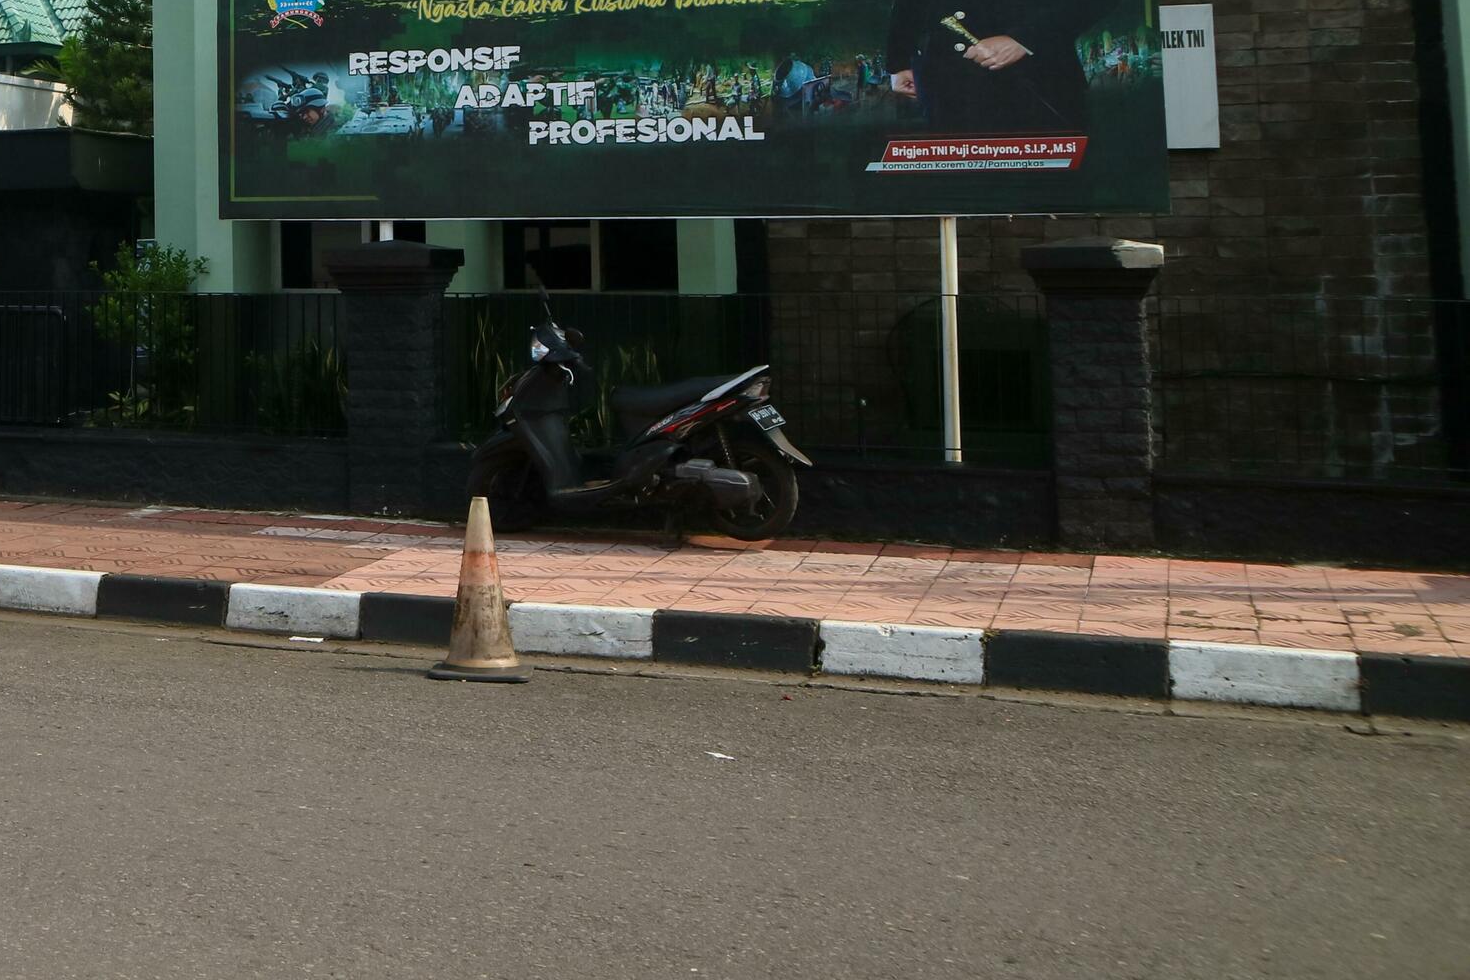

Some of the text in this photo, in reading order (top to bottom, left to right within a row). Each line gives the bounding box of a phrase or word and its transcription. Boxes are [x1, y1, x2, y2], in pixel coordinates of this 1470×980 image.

[1186, 29, 1205, 48] TNI
[349, 45, 521, 76] RESPONSIF
[454, 81, 596, 110] ADAPTIF
[528, 116, 766, 146] PROFESIONAL
[891, 146, 930, 159] Brigjen
[931, 145, 948, 156] TNI
[950, 144, 969, 158] Puji
[971, 144, 1022, 158] Cahyono,
[882, 162, 933, 170] Komandan
[935, 161, 966, 169] Korem
